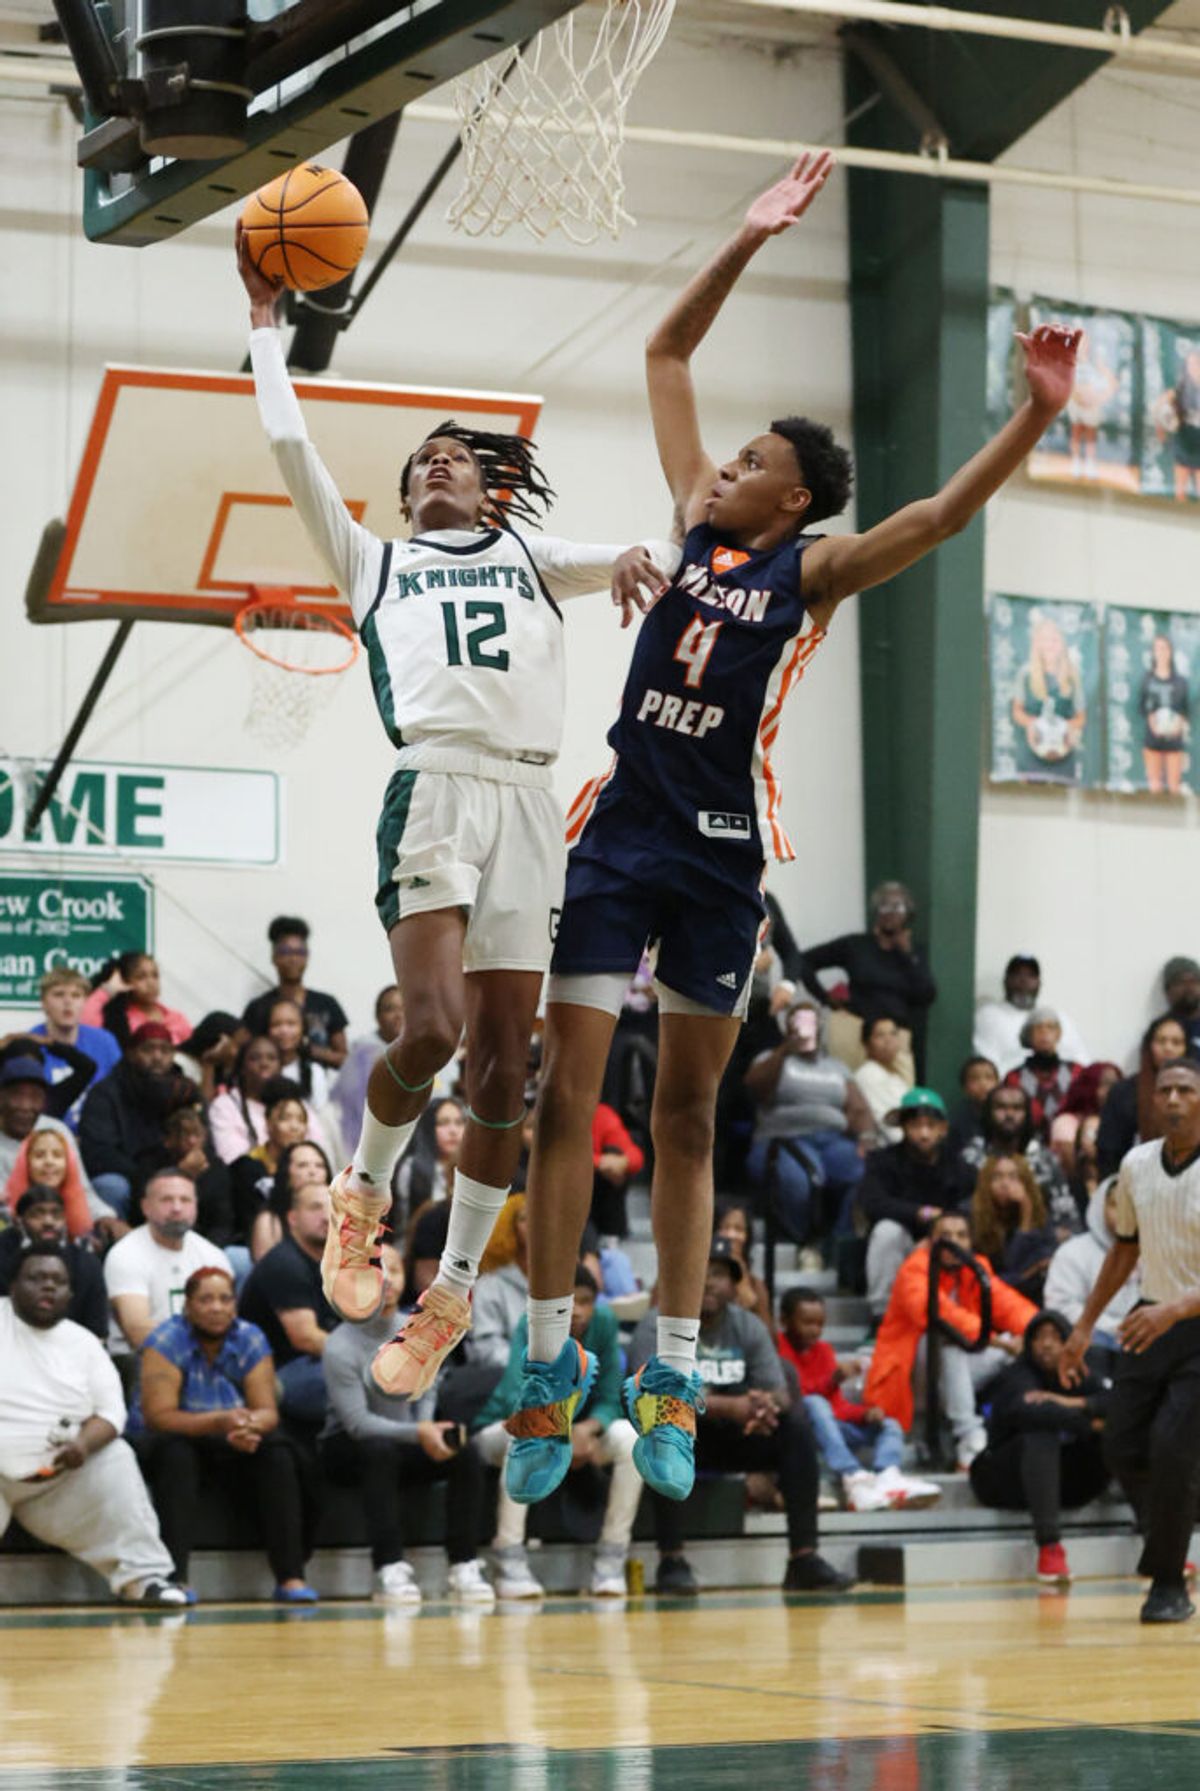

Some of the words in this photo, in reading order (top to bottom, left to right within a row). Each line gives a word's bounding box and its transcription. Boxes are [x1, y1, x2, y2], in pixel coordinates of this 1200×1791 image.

[397, 565, 535, 601] KNIGHTS
[440, 600, 509, 672] 12
[673, 611, 723, 688] 4
[636, 688, 725, 739] PREP
[0, 769, 165, 848] ME
[38, 889, 124, 919] Crook
[0, 955, 35, 976] an
[44, 948, 120, 977] Cro
